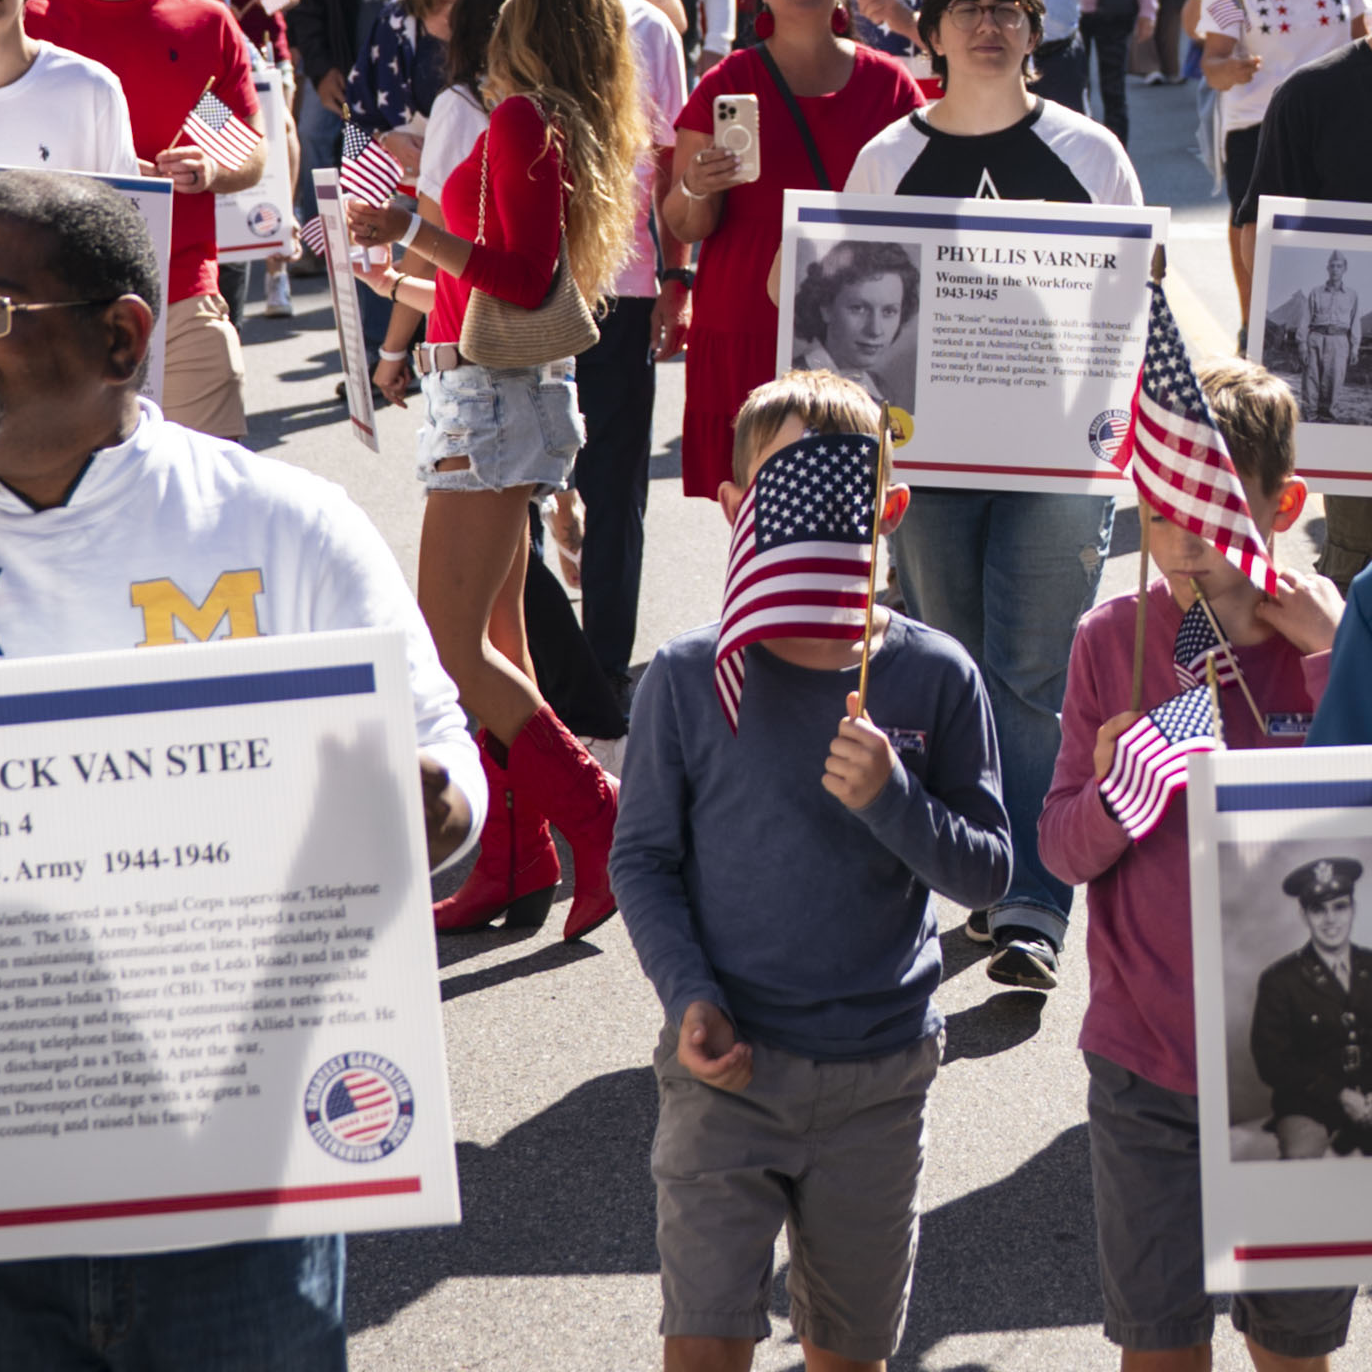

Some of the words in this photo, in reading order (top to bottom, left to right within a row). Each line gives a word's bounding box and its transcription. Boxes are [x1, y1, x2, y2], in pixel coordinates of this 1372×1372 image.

[937, 245, 1027, 264] PHYLLIS
[1033, 250, 1118, 270] VARNER
[936, 271, 983, 286] Women
[986, 274, 999, 286] in
[1002, 275, 1022, 287] the
[1027, 275, 1092, 290] Workforce
[936, 287, 997, 300] 1943-1945
[129, 568, 266, 648] M
[73, 749, 151, 783] VAN
[167, 738, 271, 776] STEE
[19, 814, 32, 834] 4
[17, 860, 84, 882] Army
[106, 842, 230, 873] 1944-1946
